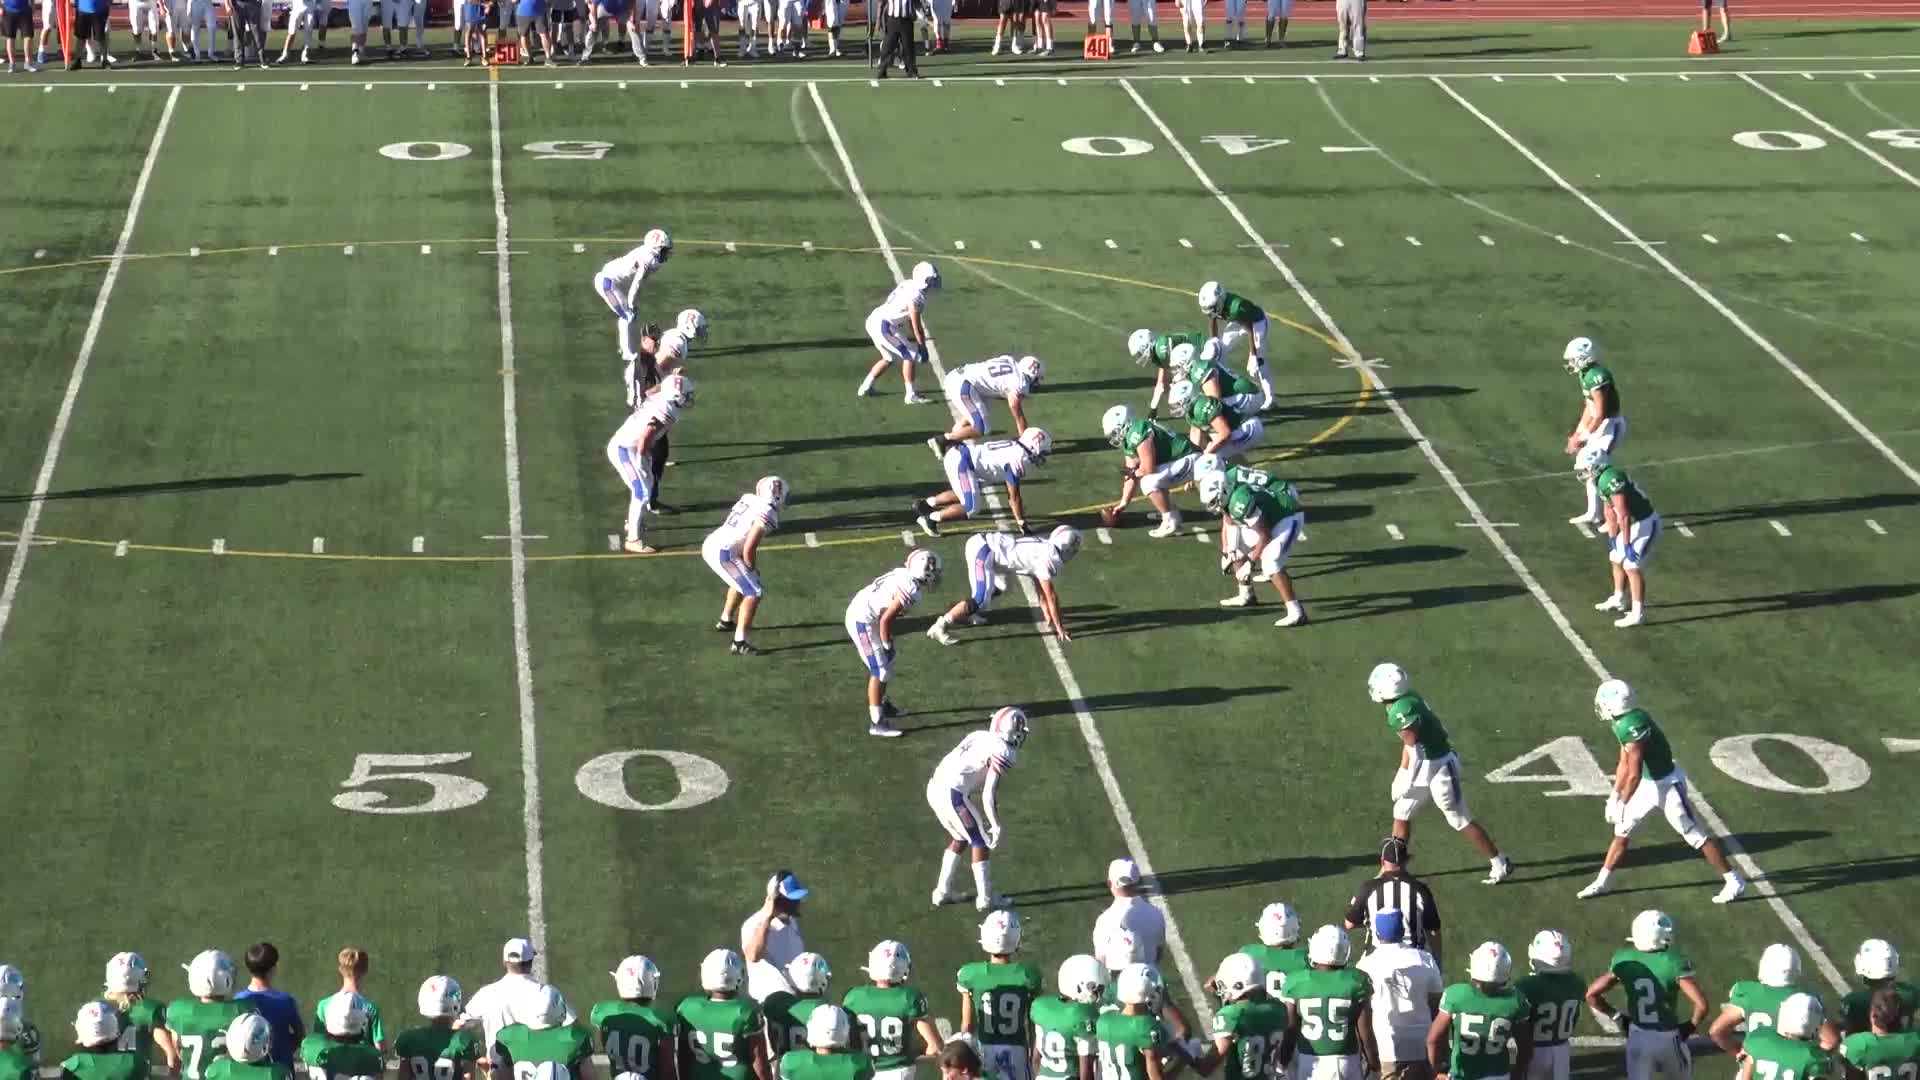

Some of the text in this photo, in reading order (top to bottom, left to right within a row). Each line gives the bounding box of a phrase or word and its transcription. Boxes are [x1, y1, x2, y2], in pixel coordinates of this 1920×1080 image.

[1087, 38, 1108, 58] 40
[980, 991, 1021, 1035] 19
[1299, 997, 1352, 1042] 55
[1532, 999, 1578, 1042] 20
[1633, 976, 1659, 1023] 2
[606, 1029, 651, 1074] 40
[687, 1029, 737, 1068] 65
